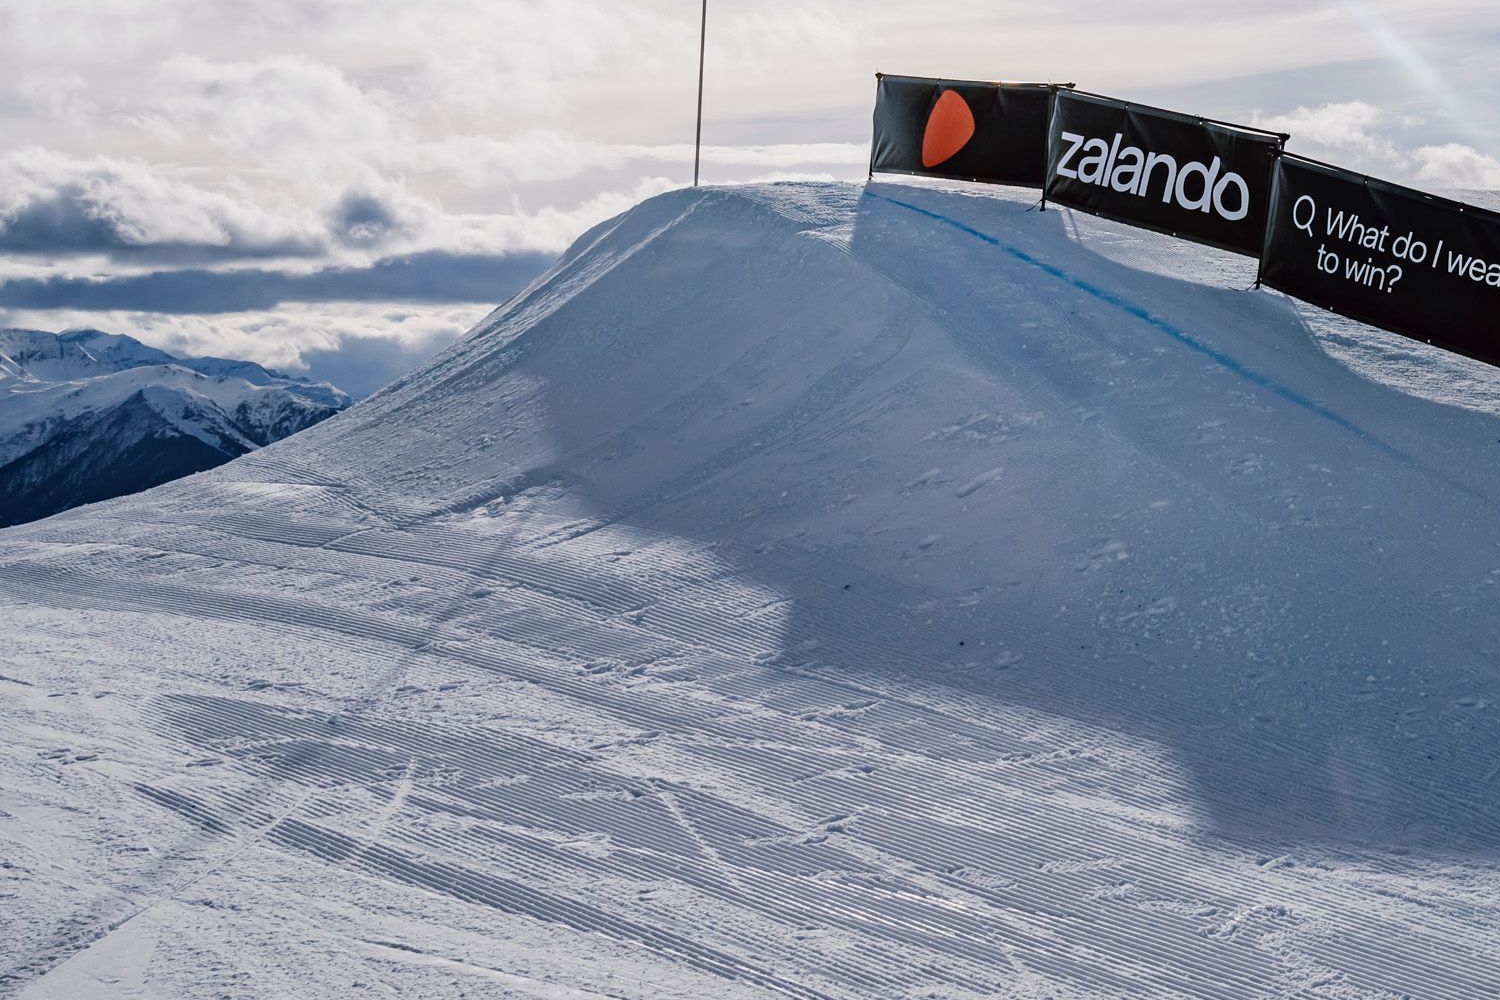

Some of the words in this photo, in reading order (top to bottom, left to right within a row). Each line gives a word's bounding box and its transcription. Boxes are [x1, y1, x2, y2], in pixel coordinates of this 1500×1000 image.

[1056, 131, 1250, 221] zalando
[1292, 194, 1316, 238] Q
[1326, 207, 1390, 253] What
[1392, 231, 1427, 263] do
[1431, 239, 1444, 268] I
[1317, 243, 1339, 274] to
[1345, 257, 1403, 294] win?
